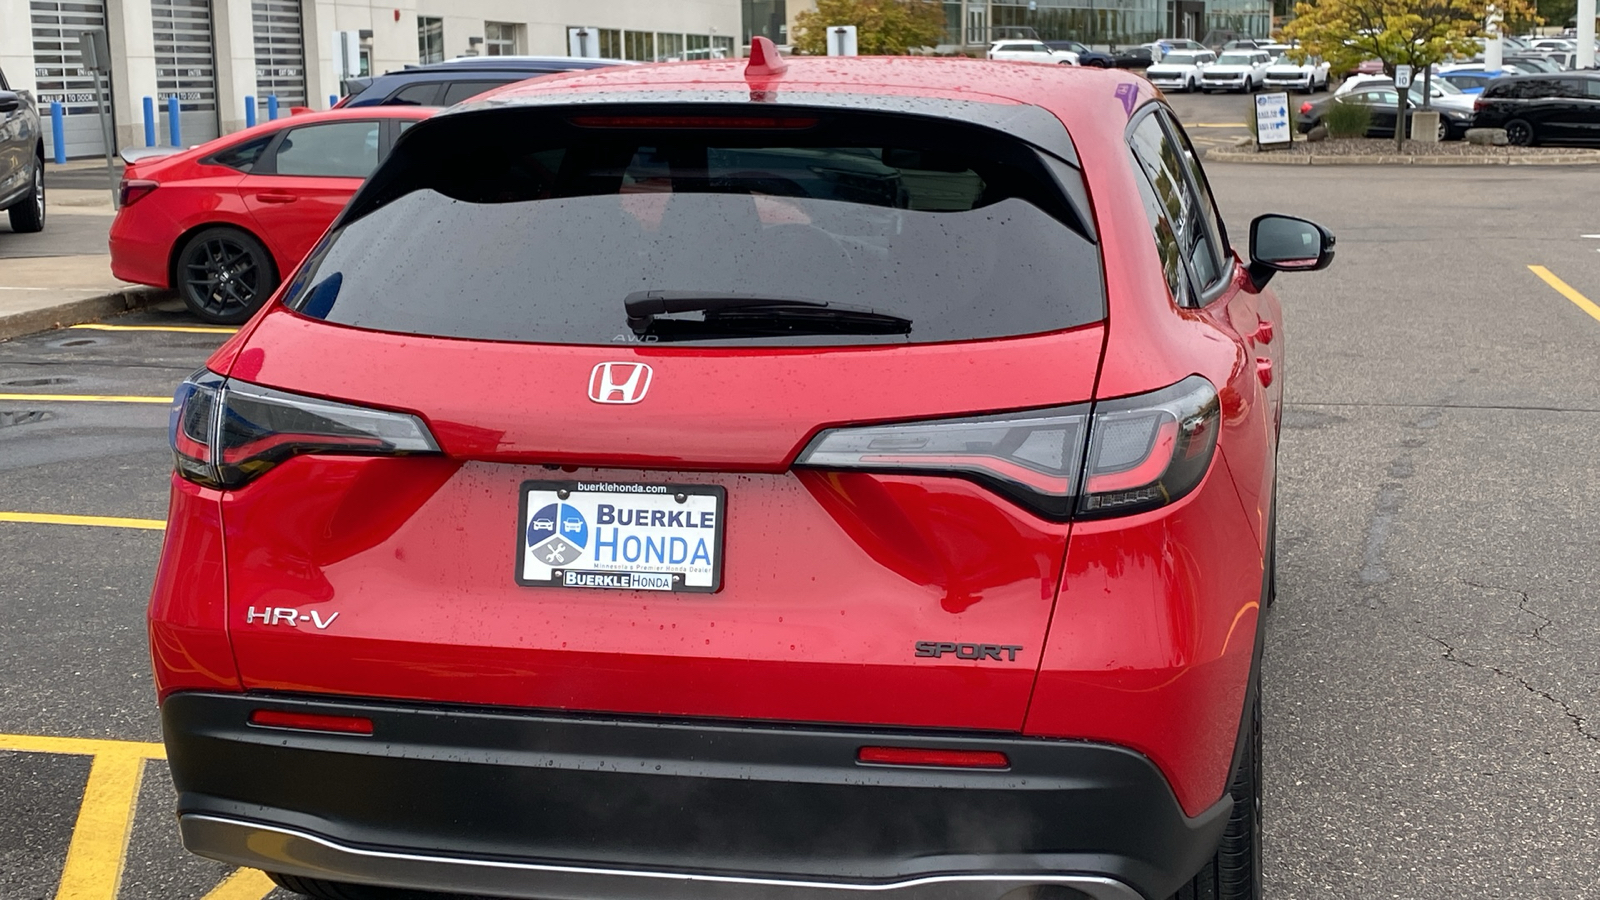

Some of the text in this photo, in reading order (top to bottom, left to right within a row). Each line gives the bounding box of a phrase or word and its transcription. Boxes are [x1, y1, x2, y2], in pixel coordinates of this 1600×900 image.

[1398, 76, 1408, 85] 10
[612, 334, 659, 343] AWD
[577, 482, 667, 493] buerklehonda.com
[597, 504, 714, 529] BUERKLE
[594, 527, 711, 565] HONDA
[565, 572, 670, 588] BUERKLE HONDA
[247, 606, 340, 629] HR-V
[915, 641, 1023, 661] SPORT
